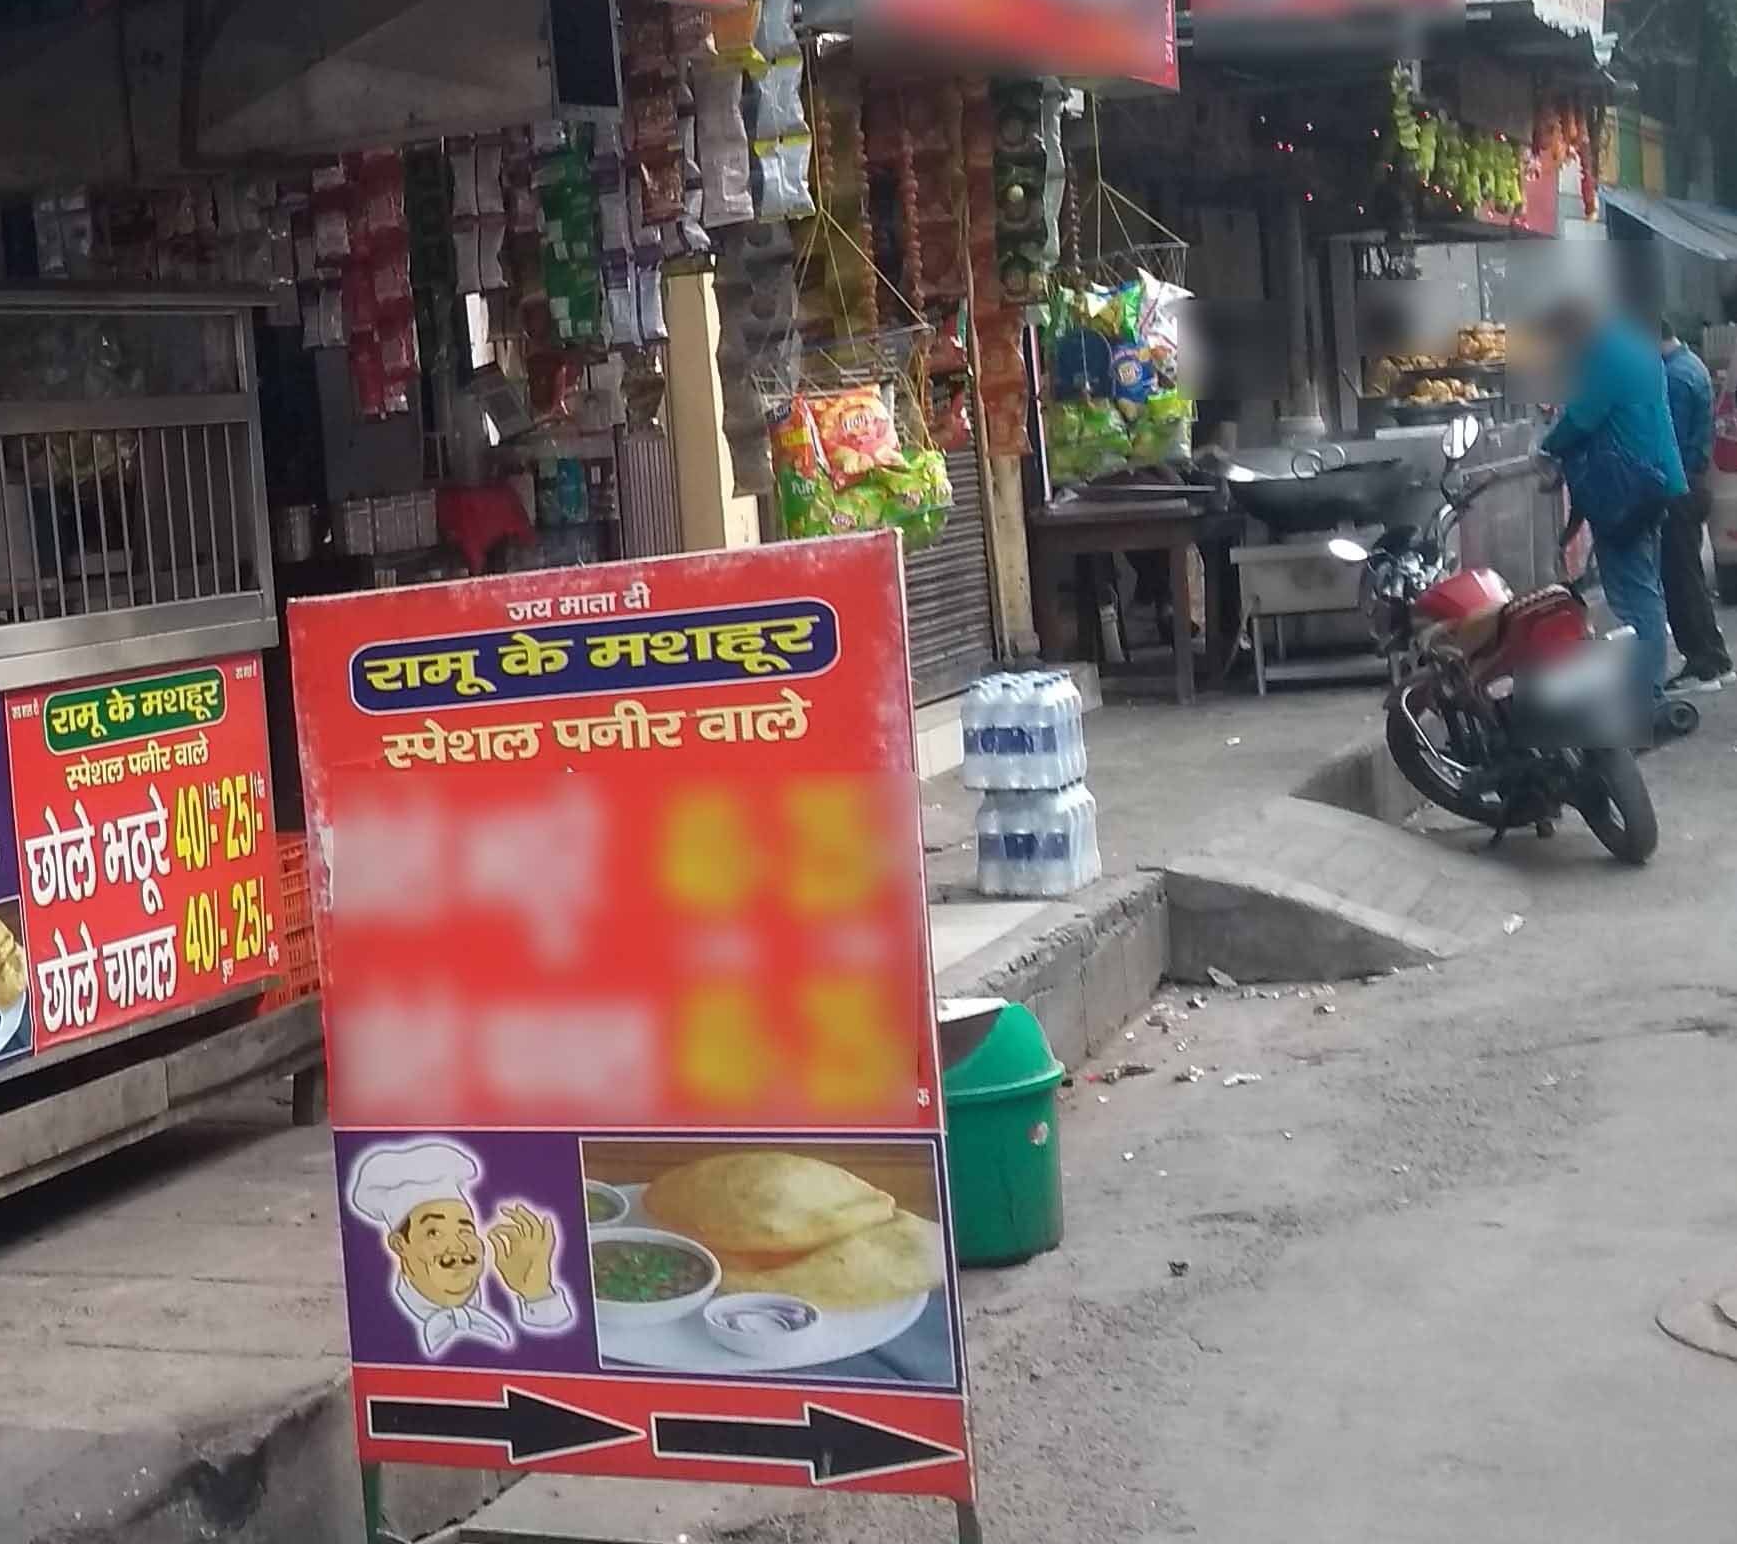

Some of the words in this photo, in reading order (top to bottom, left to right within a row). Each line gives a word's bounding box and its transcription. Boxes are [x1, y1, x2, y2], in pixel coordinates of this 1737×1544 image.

[506, 597, 552, 622] जय
[558, 590, 616, 617] माता
[622, 582, 652, 610] दी
[364, 648, 496, 696] रामू
[498, 631, 573, 678] के
[586, 614, 821, 675] मशहूर
[50, 700, 108, 738] रामू
[106, 688, 136, 723] के
[140, 678, 220, 721] मशहूर
[381, 718, 544, 770] स्पेशल
[553, 699, 687, 753] पनीर
[697, 687, 813, 743] वाले
[65, 754, 124, 792] स्पेशल
[127, 739, 172, 777] पनीर
[174, 730, 209, 767] वाले
[25, 799, 97, 907] छोले
[102, 782, 171, 915] भठूरे
[37, 920, 99, 1033] छोले
[101, 924, 177, 1009] चावल
